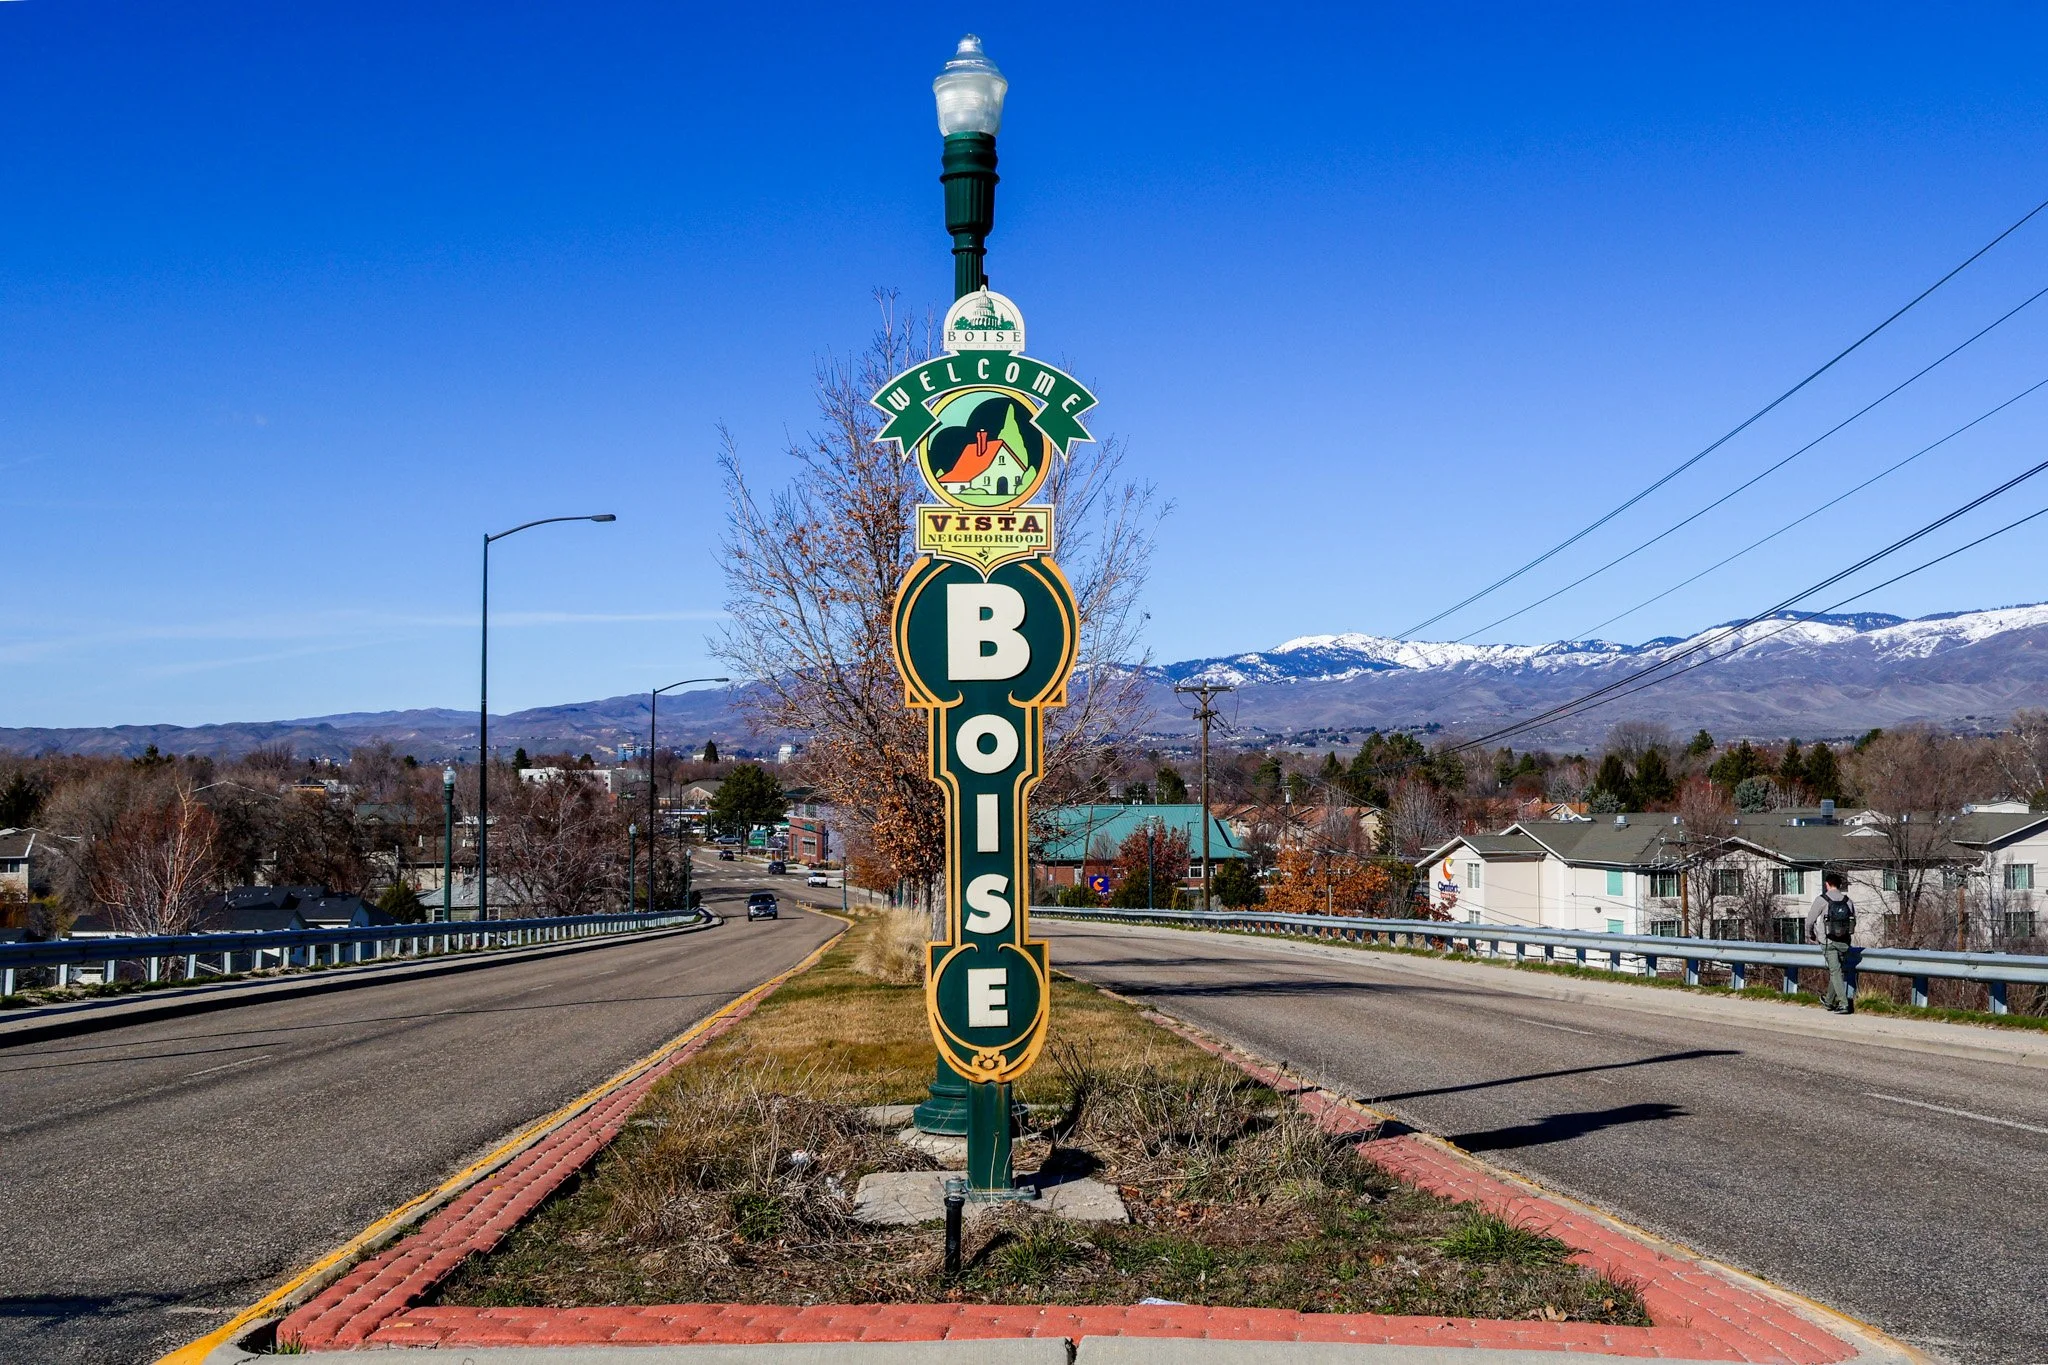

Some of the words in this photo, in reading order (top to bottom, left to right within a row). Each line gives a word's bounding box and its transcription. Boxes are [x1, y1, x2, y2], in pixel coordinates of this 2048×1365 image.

[948, 331, 1021, 342] BOISE
[887, 358, 1081, 413] WELCOME
[928, 515, 1043, 533] VISTA
[928, 534, 1044, 543] NEIGHBORHOOD
[947, 583, 1031, 1028] BOISE
